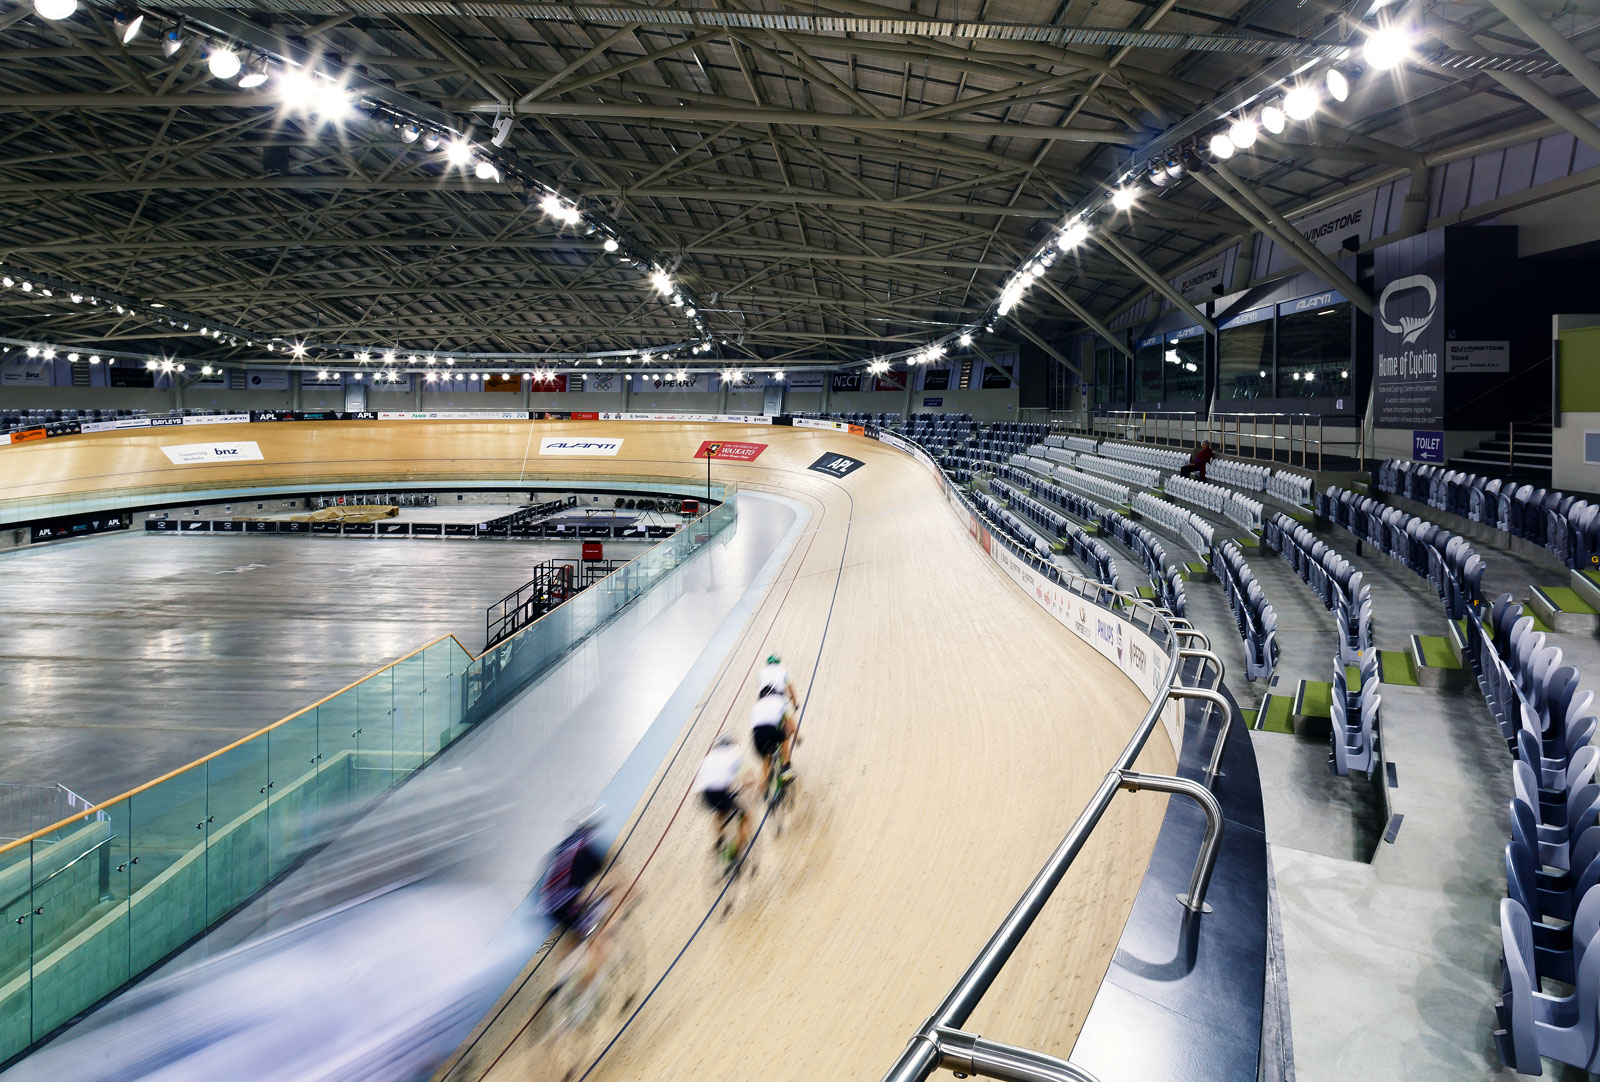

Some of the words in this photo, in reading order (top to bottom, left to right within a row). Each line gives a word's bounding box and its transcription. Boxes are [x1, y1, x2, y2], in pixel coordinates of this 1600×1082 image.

[1379, 353, 1398, 377] Home
[1400, 351, 1408, 379] of
[1409, 349, 1437, 379] Cycling
[662, 379, 697, 388] PERRY
[834, 375, 859, 387] NZCT
[1415, 437, 1441, 450] TOILET
[214, 448, 239, 456] bnz
[721, 447, 755, 456] WAIKATO
[826, 457, 854, 473] APL
[39, 528, 52, 537] APL
[1591, 555, 1599, 563] G
[1473, 599, 1480, 607] F
[1097, 618, 1114, 646] PHILIPS
[1133, 643, 1148, 675] PERRY
